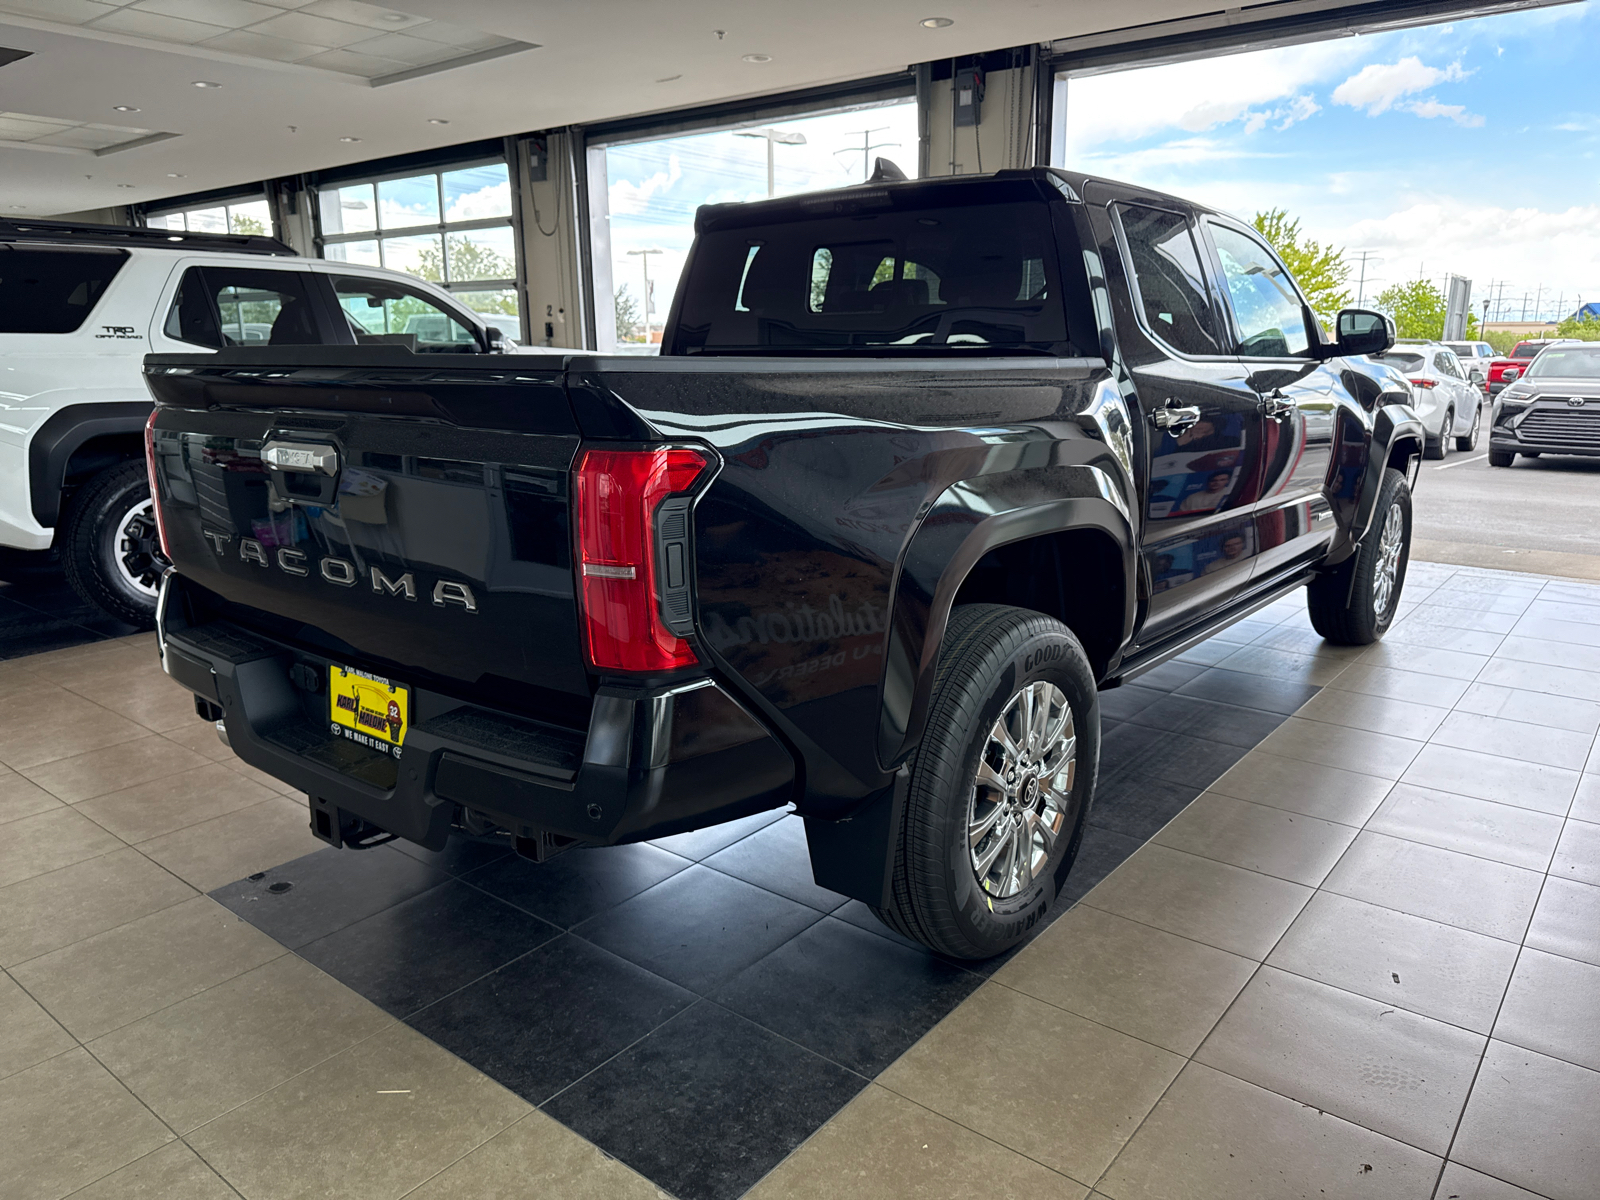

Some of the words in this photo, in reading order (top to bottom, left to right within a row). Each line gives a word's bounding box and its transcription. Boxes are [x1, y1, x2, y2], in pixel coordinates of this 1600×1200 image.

[546, 304, 553, 317] 2
[101, 325, 135, 335] TRD
[277, 449, 313, 465] TOYOTA
[203, 530, 479, 614] TACOMA
[344, 665, 355, 675] KARL
[1024, 642, 1094, 694] GOODYEAR
[336, 694, 355, 713] KARL
[389, 705, 398, 718] 32
[358, 711, 388, 733] MALONE
[344, 729, 353, 740] WE
[353, 732, 368, 745] MAKE
[369, 738, 375, 748] IT
[375, 741, 389, 753] EASY
[970, 900, 1047, 941] WRANGLER
